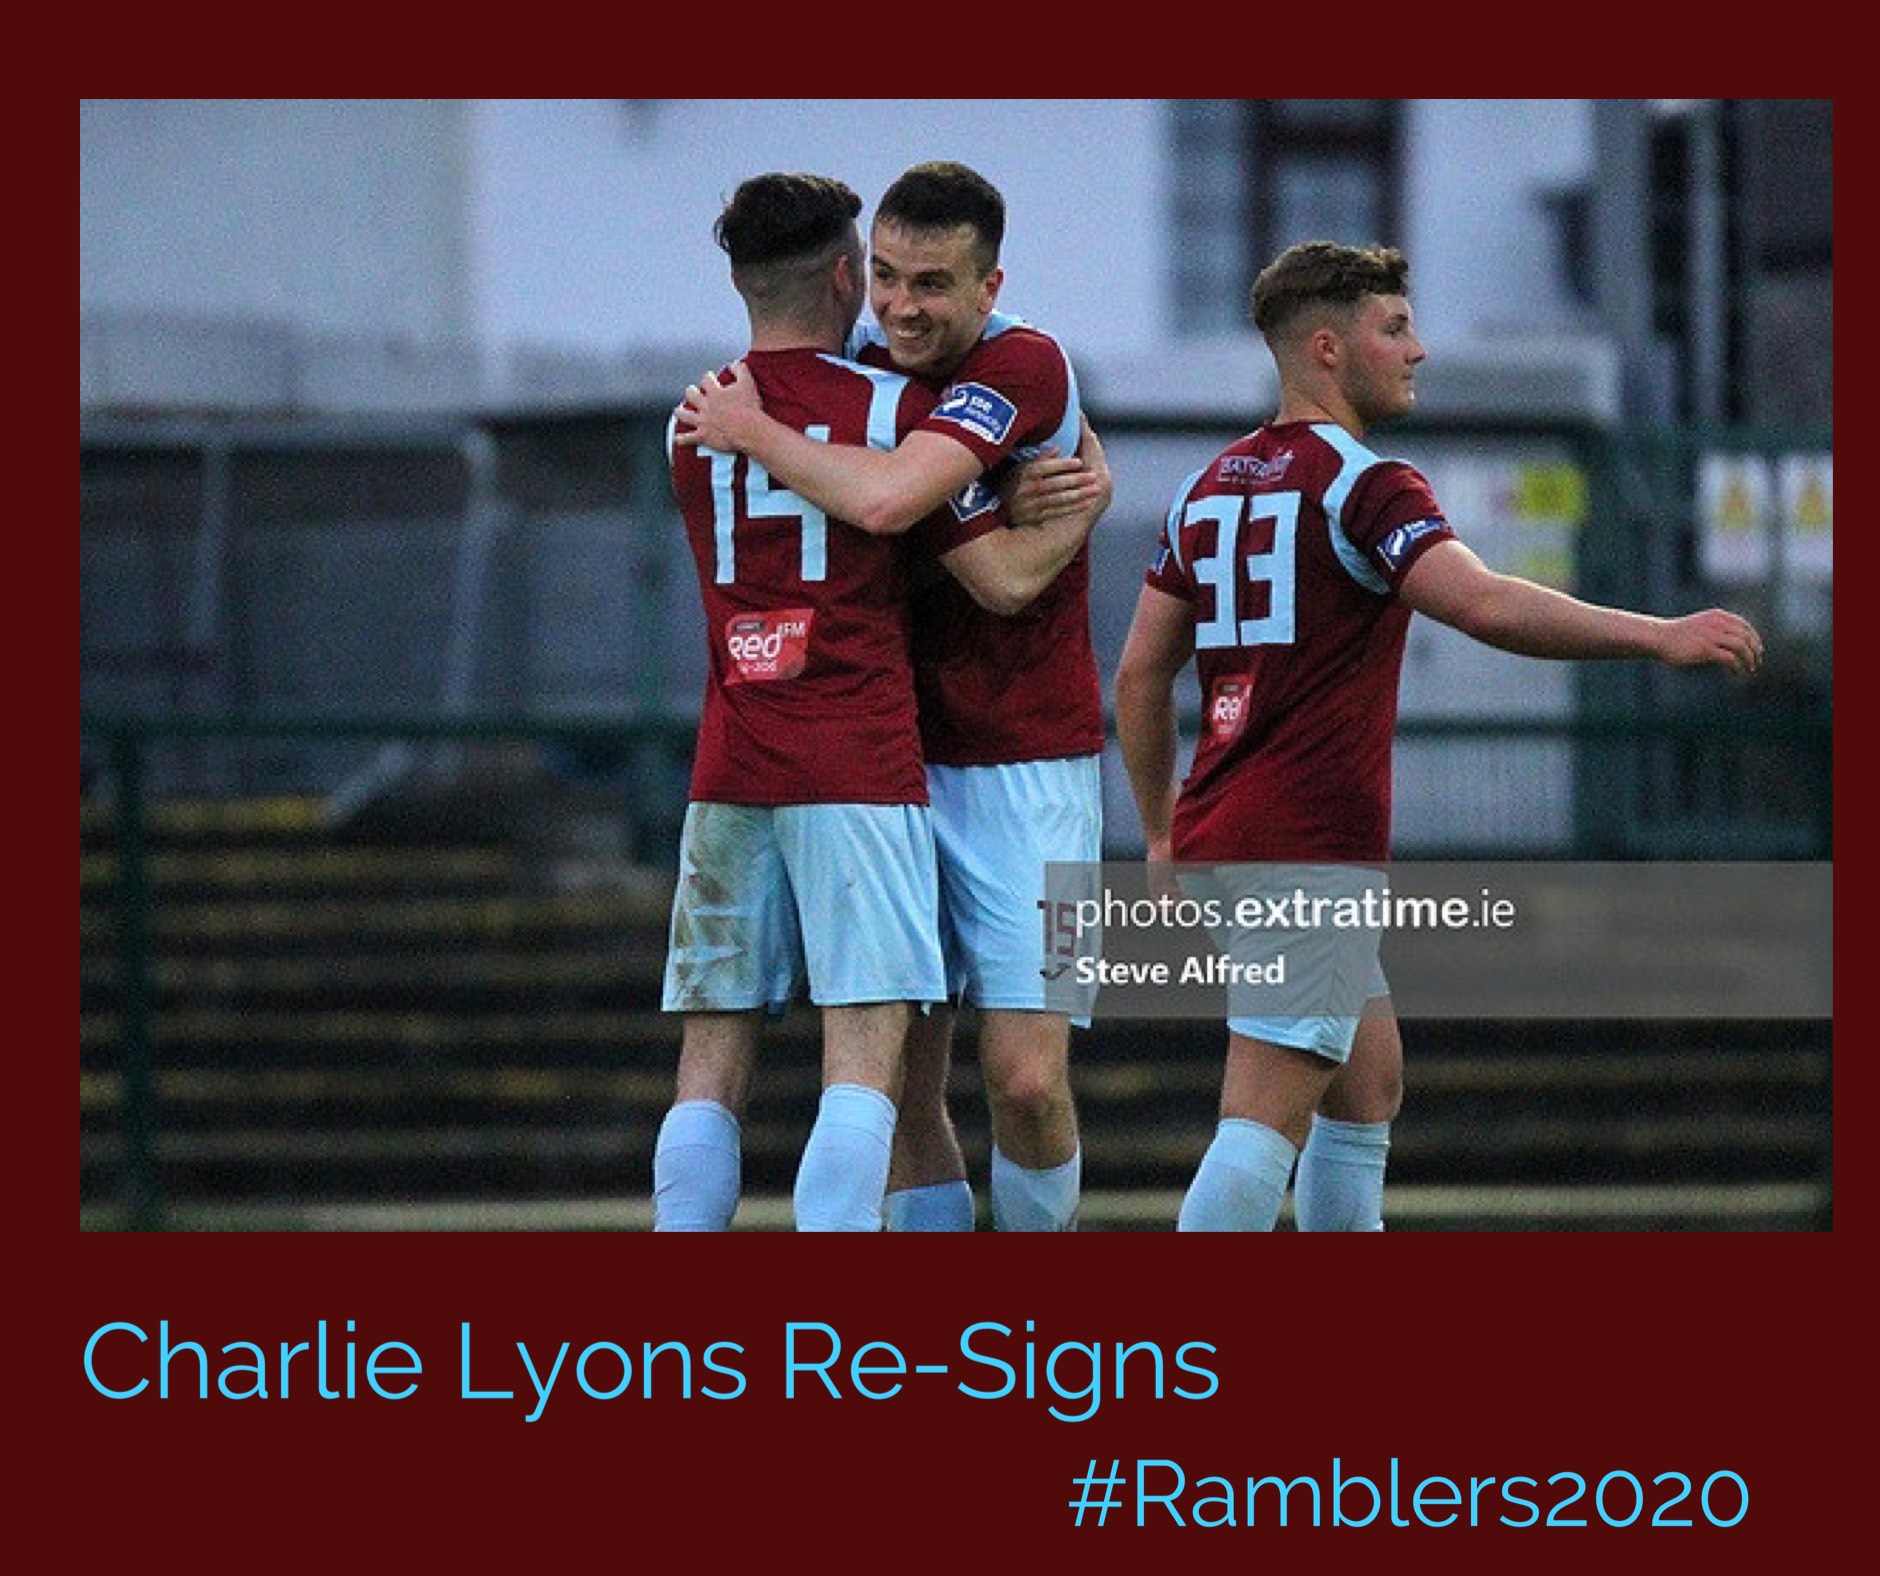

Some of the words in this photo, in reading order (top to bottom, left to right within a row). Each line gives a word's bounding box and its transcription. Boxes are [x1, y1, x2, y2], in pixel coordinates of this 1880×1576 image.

[697, 424, 830, 584] 14
[1183, 491, 1301, 649] 33
[1036, 900, 1078, 957] 15
